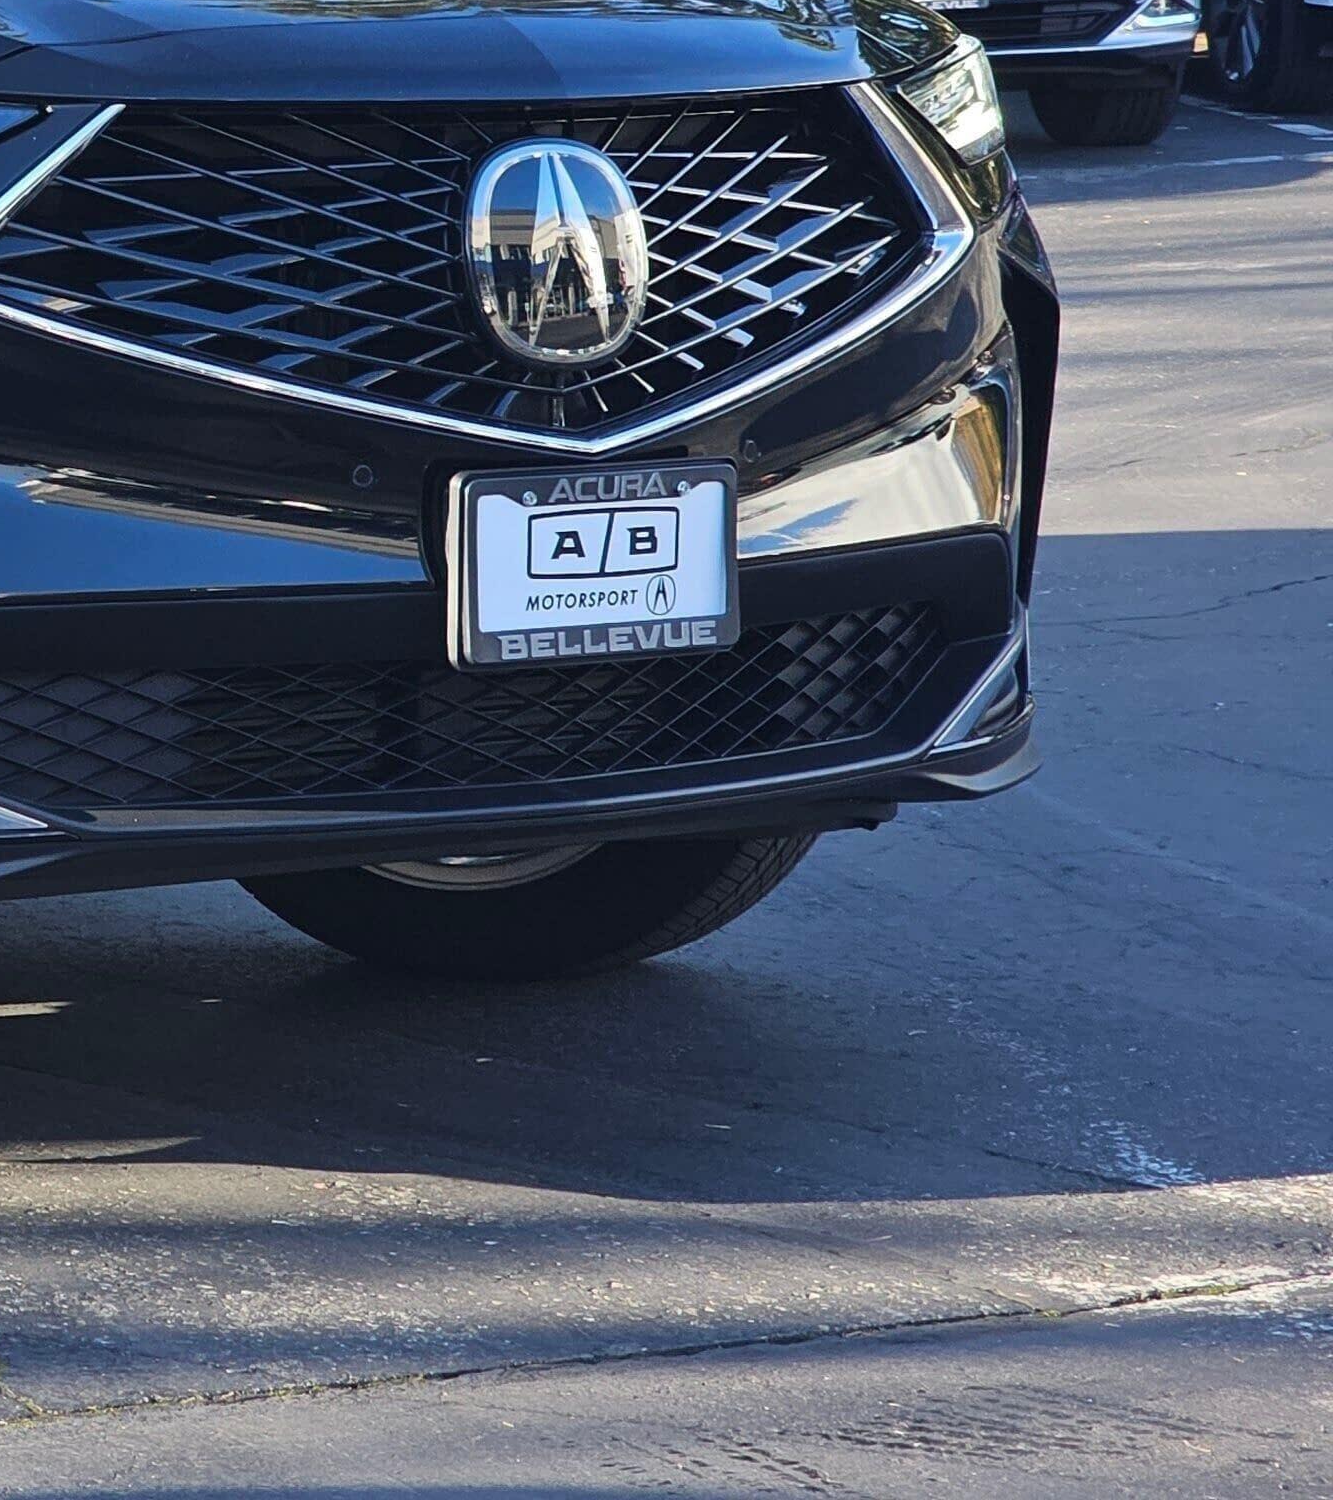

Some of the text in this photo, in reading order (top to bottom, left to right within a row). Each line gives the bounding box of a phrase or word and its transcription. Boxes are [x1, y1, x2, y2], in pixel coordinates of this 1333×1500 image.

[548, 472, 668, 503] ACURA
[525, 588, 639, 612] MOTORSPORT
[497, 620, 718, 661] BELLEVUE
